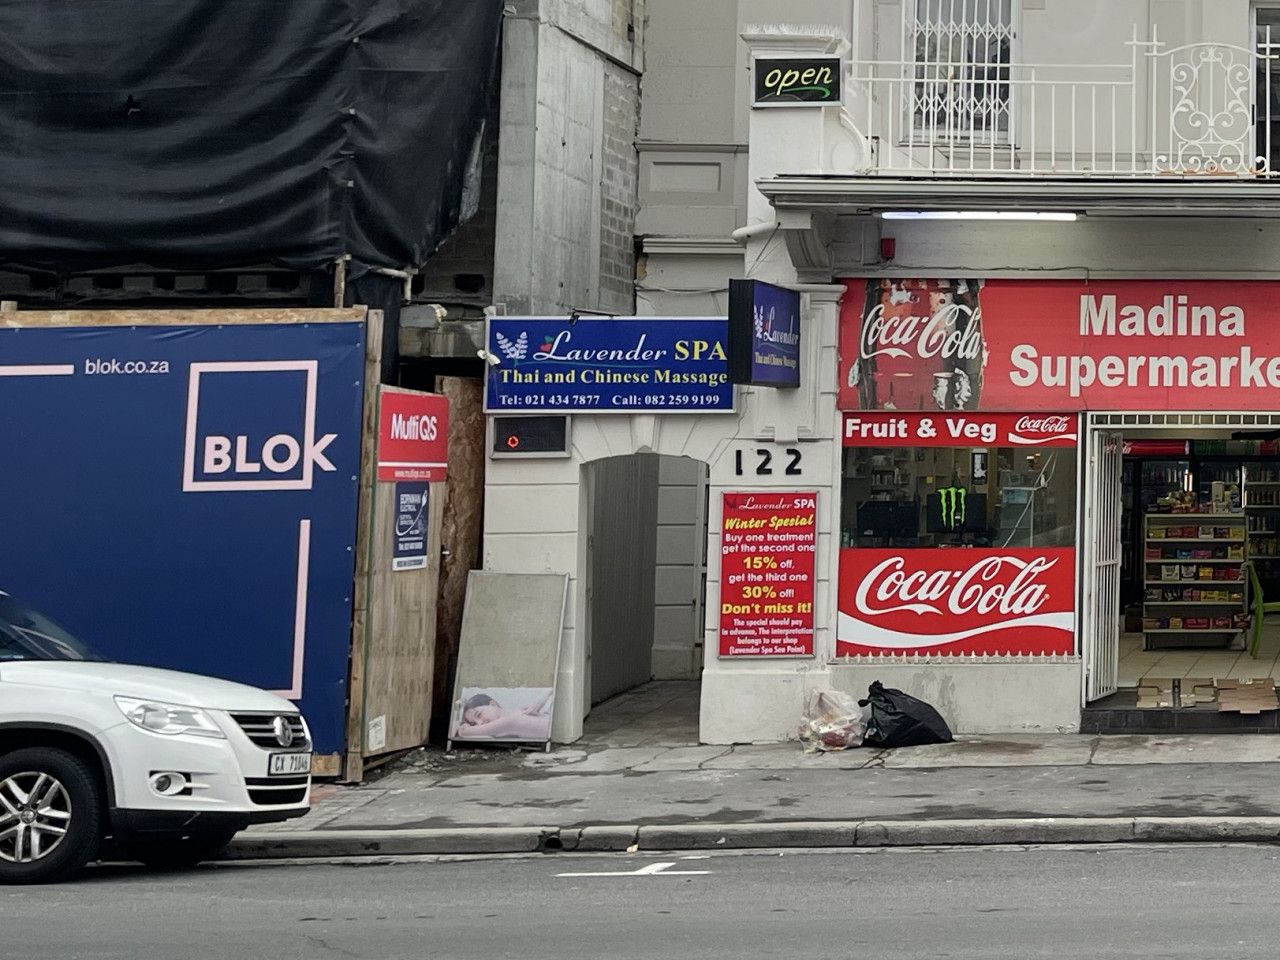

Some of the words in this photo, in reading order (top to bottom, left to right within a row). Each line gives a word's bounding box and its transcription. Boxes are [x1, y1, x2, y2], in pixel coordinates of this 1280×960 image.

[765, 67, 832, 96] open
[1080, 294, 1245, 336] Madina
[860, 304, 982, 359] Coca-Cola
[533, 331, 667, 361] Lavender
[675, 340, 728, 361] SPA
[85, 359, 169, 375] blok.co.za
[501, 369, 540, 384] Thai
[545, 370, 575, 384] and
[581, 369, 649, 384] Chinese
[654, 369, 728, 387] Massage
[500, 395, 522, 405] Tel:
[525, 395, 545, 405] 021
[548, 395, 569, 405] 434
[572, 395, 600, 405] 7877
[612, 395, 641, 405] Call:
[644, 395, 666, 405] 082
[668, 395, 690, 405] 259
[692, 395, 720, 405] 9199
[845, 418, 908, 438] Fruit
[917, 418, 937, 438] &
[946, 418, 997, 442] Veg
[1015, 415, 1071, 433] Coca-Cola
[203, 434, 338, 474] BLOK
[735, 448, 802, 475] 122
[738, 497, 792, 509] Lavender
[794, 498, 815, 509] SPA
[725, 517, 767, 530] Winter
[725, 533, 743, 543] Buy
[745, 534, 764, 542] one
[767, 532, 814, 541] treatment
[722, 544, 739, 554] get
[741, 543, 756, 552] the
[759, 543, 796, 552] second
[797, 544, 816, 552] one
[743, 556, 777, 569] 15%
[729, 573, 745, 584] get
[748, 573, 763, 581] the
[766, 572, 788, 581] third
[789, 573, 808, 581] one
[855, 556, 1059, 616] Coca-Cola
[742, 585, 777, 598] 30%
[779, 589, 794, 598] off!
[764, 602, 793, 613] miss
[797, 602, 812, 613] it!
